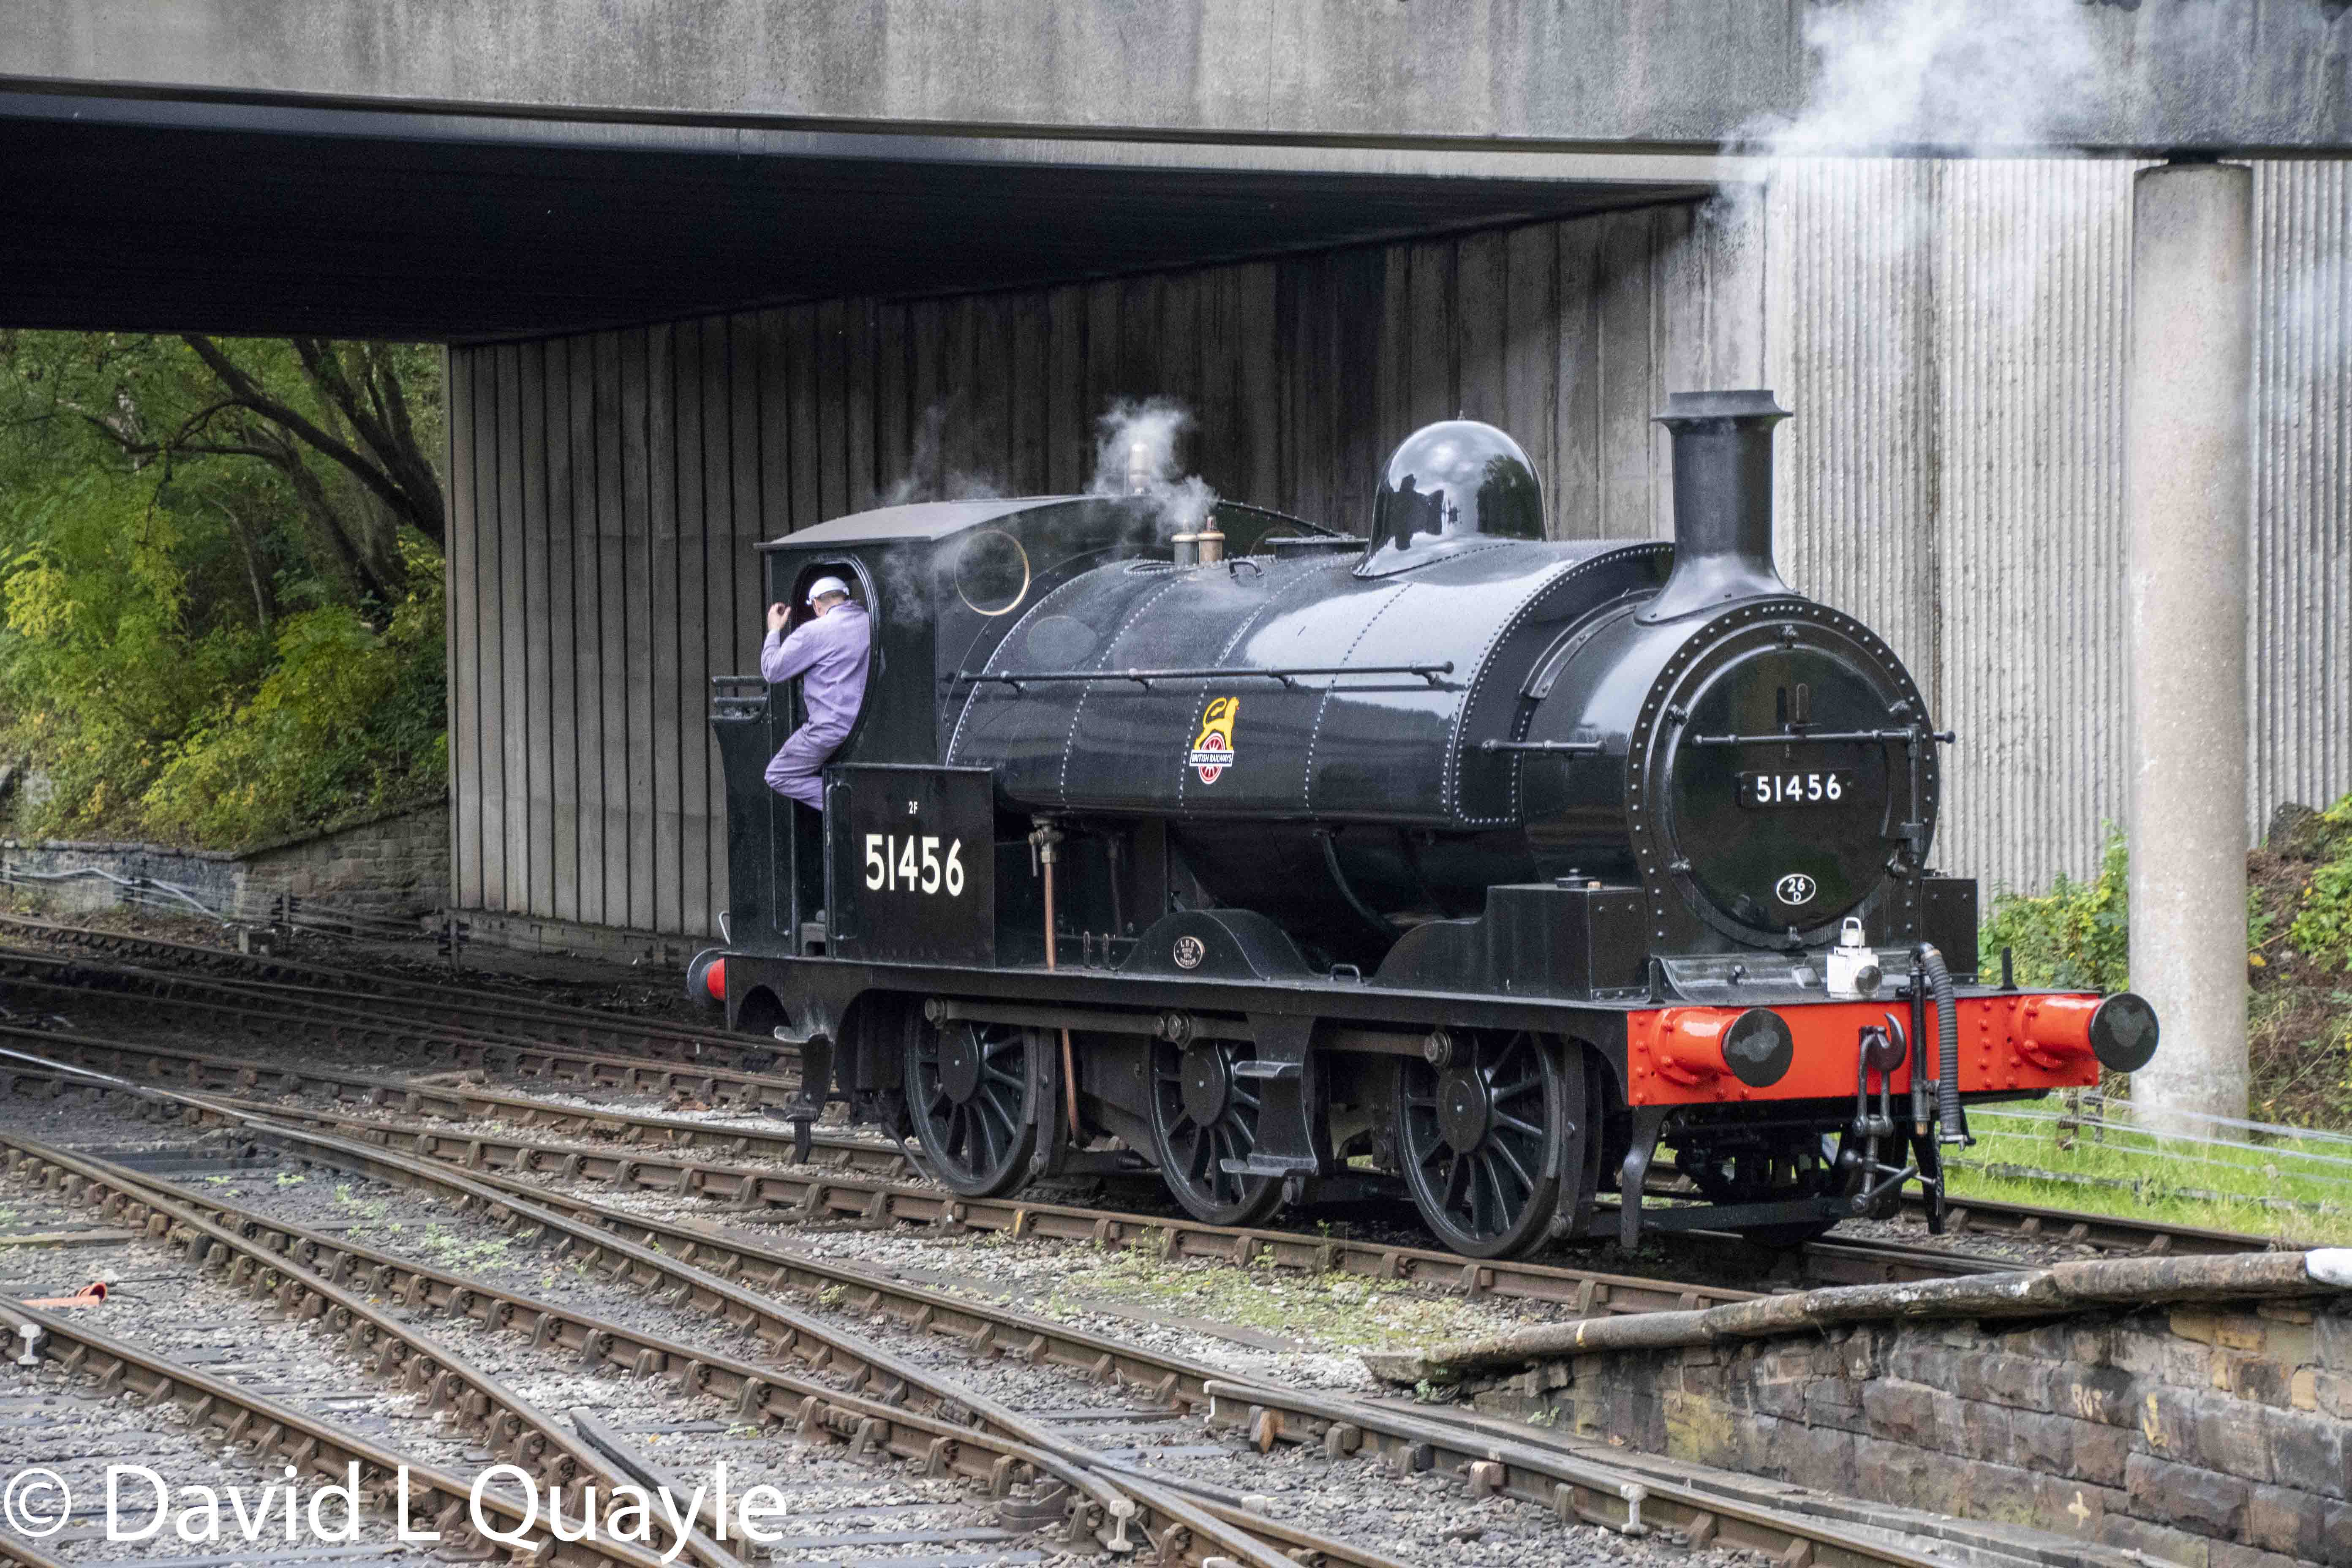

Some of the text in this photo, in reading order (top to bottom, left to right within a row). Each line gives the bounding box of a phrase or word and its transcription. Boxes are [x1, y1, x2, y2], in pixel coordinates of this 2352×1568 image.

[1191, 754, 1231, 763] BRITISH RAILWAYS
[1757, 773, 1841, 802] 51456
[909, 801, 918, 814] 2F
[866, 834, 964, 896] 51456
[1787, 878, 1805, 892] 26
[1794, 891, 1801, 902] D
